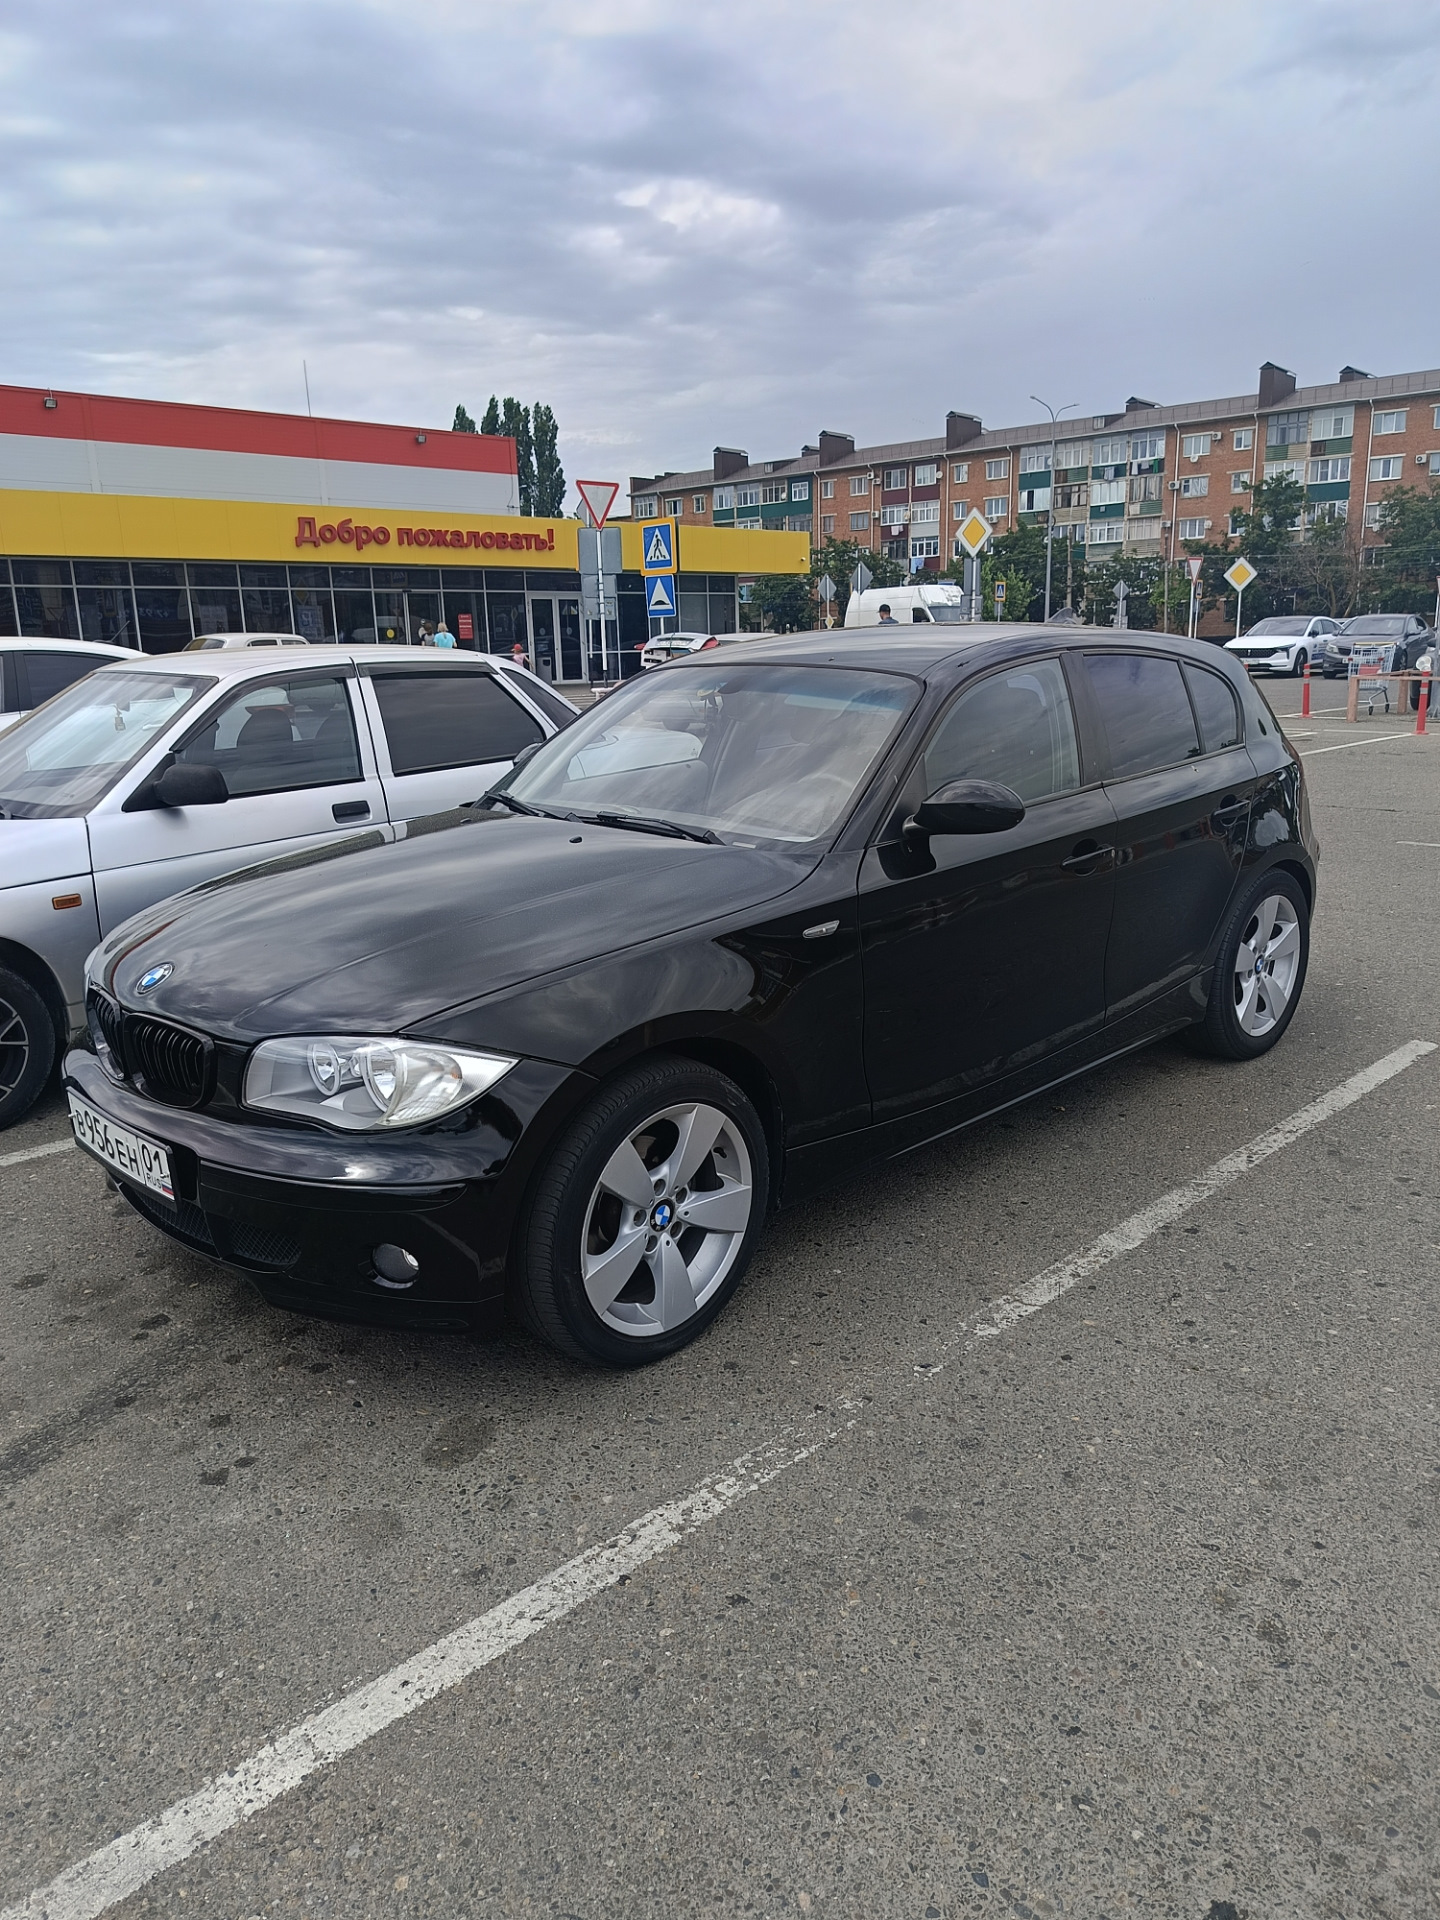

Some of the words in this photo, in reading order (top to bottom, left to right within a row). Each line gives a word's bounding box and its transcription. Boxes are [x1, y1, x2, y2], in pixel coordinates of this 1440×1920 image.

[295, 516, 390, 551] Добро
[397, 527, 555, 551] пожаловать!
[141, 1143, 163, 1175] 01
[146, 1172, 162, 1189] RUS
